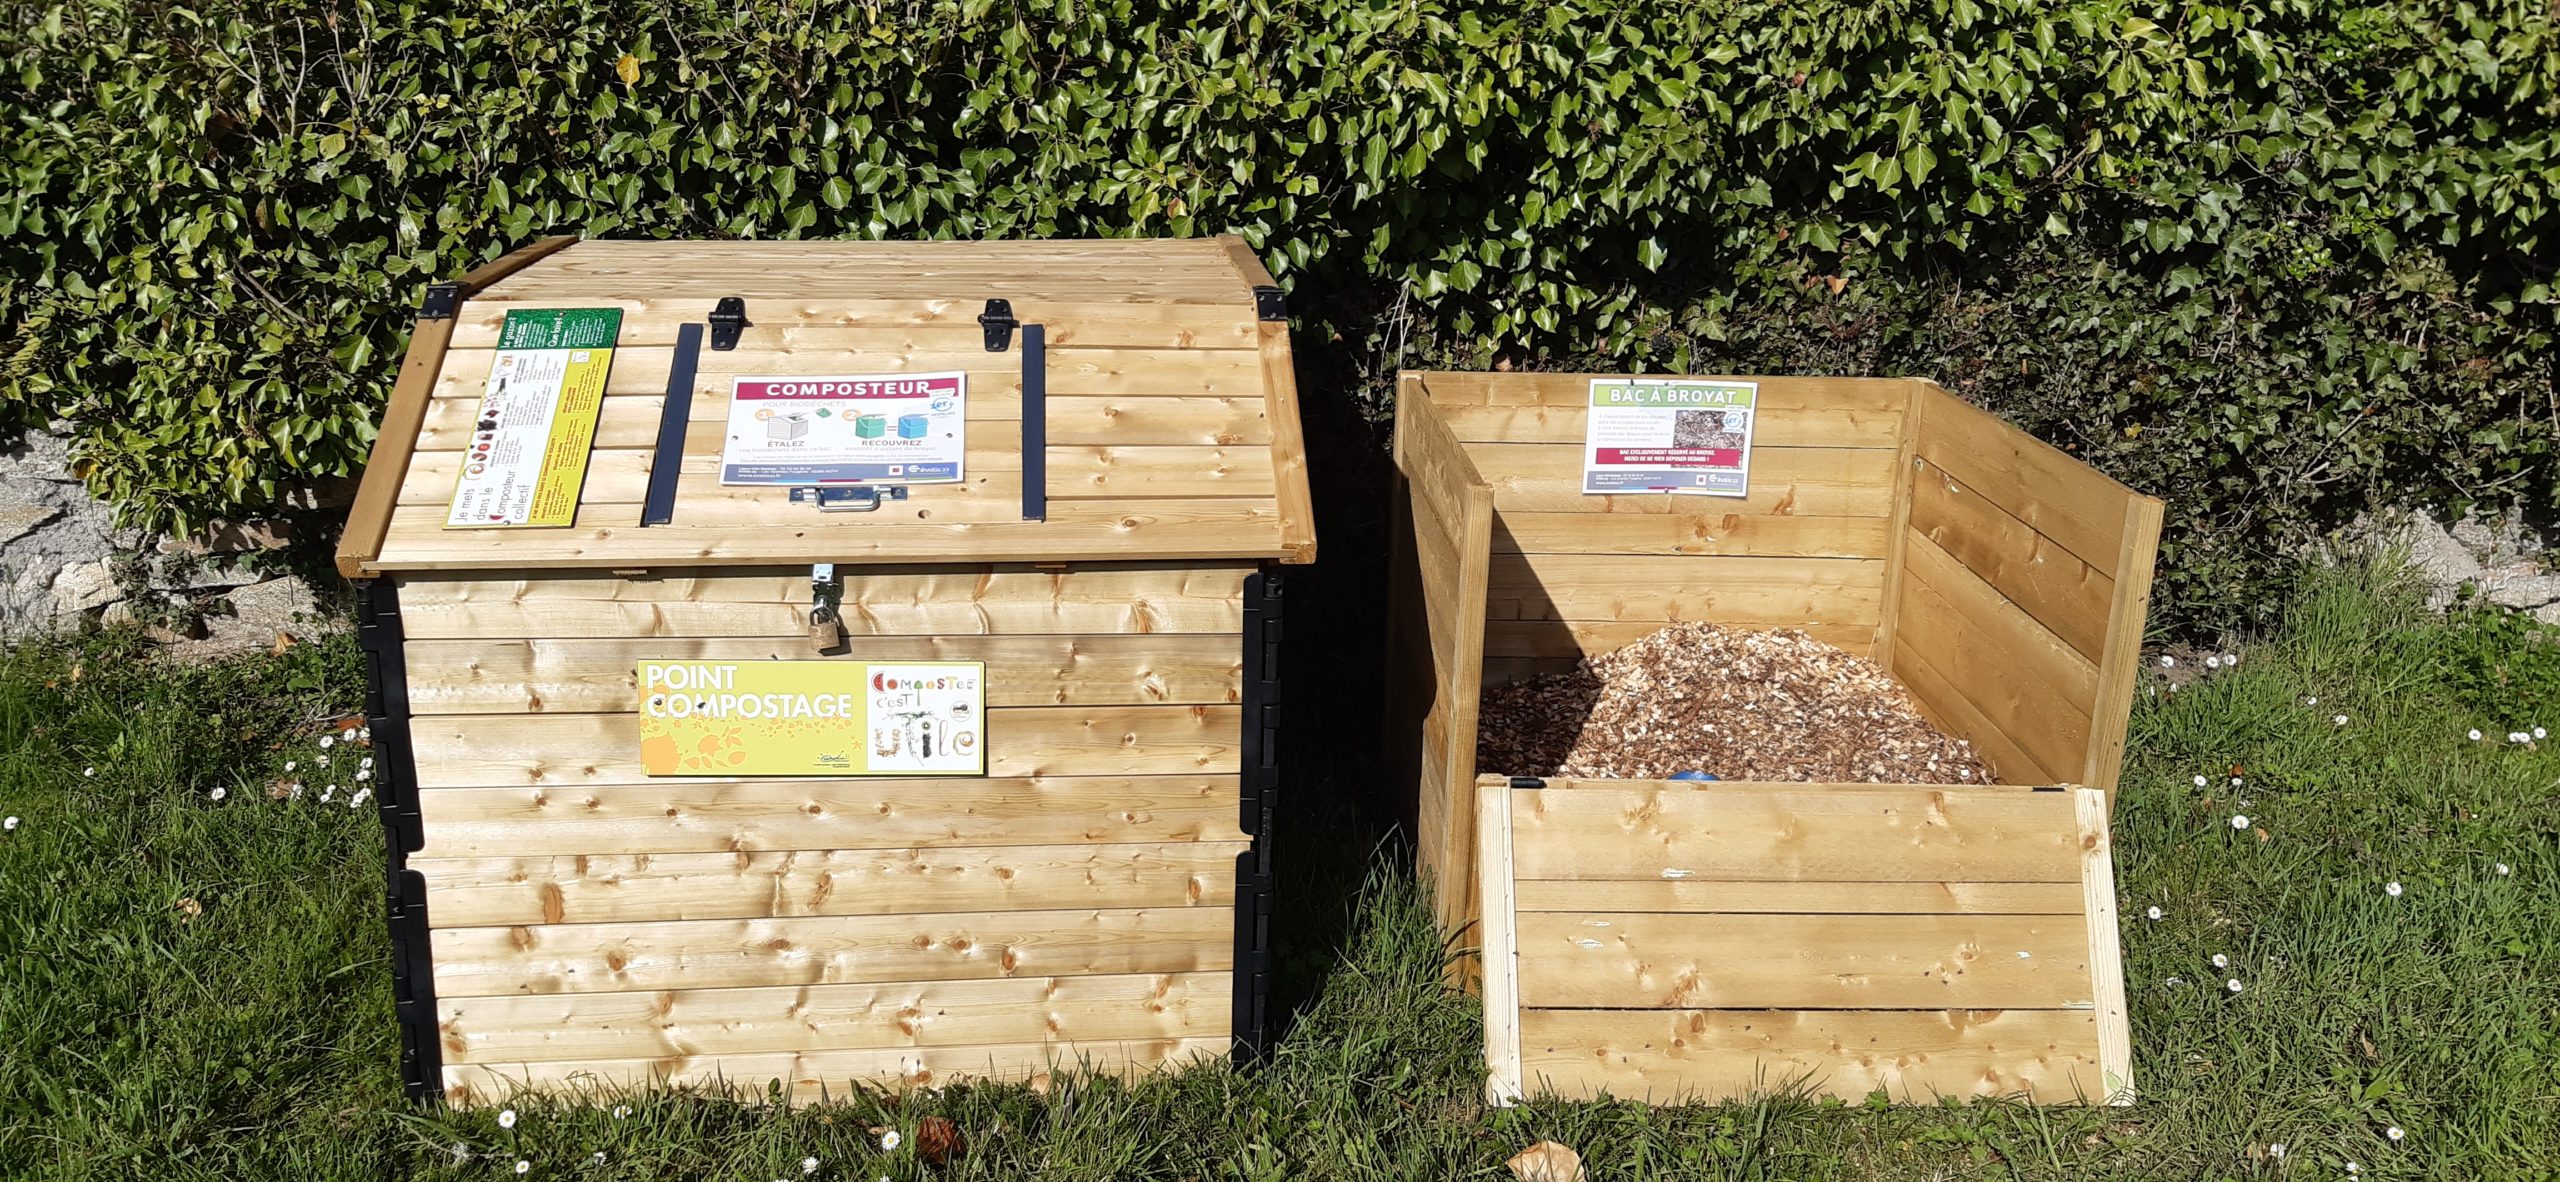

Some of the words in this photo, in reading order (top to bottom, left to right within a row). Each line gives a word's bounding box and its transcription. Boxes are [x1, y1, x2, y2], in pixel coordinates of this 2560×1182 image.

[766, 381, 929, 396] COMPOSTEUR
[1610, 388, 1645, 402] BAC
[1650, 386, 1662, 402] À
[1667, 389, 1736, 404] BROYAT
[789, 400, 846, 408] BIODÉCHETS
[478, 487, 494, 495] le
[454, 512, 468, 522] Je
[462, 488, 475, 508] mets
[471, 498, 490, 520] dans
[512, 485, 531, 520] collectif
[646, 665, 737, 690] POINT
[647, 693, 852, 719] COMPOSTAGE
